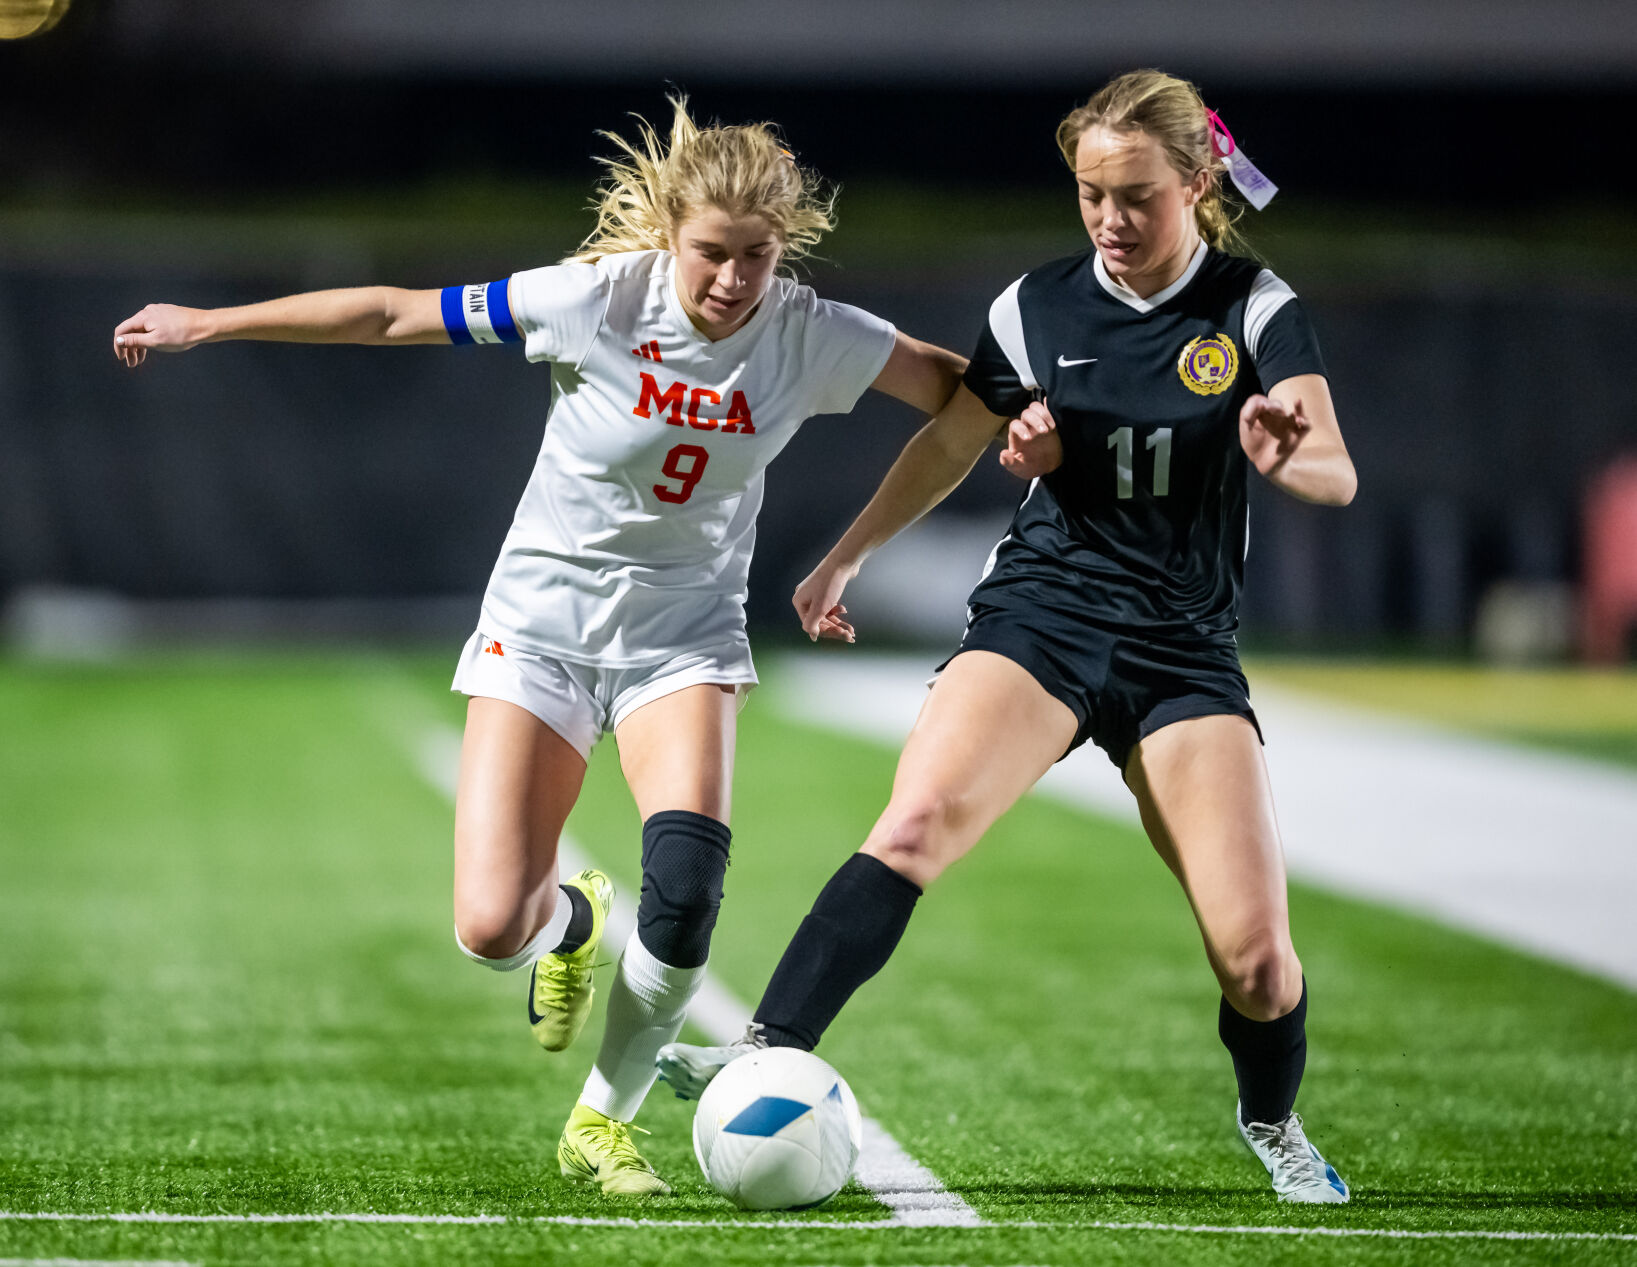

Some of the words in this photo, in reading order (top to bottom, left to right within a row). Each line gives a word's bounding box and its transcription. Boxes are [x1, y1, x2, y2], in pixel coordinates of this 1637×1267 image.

[469, 285, 486, 313] TAIN
[632, 371, 756, 434] MCA
[652, 443, 709, 504] 9
[1107, 426, 1172, 499] 11
